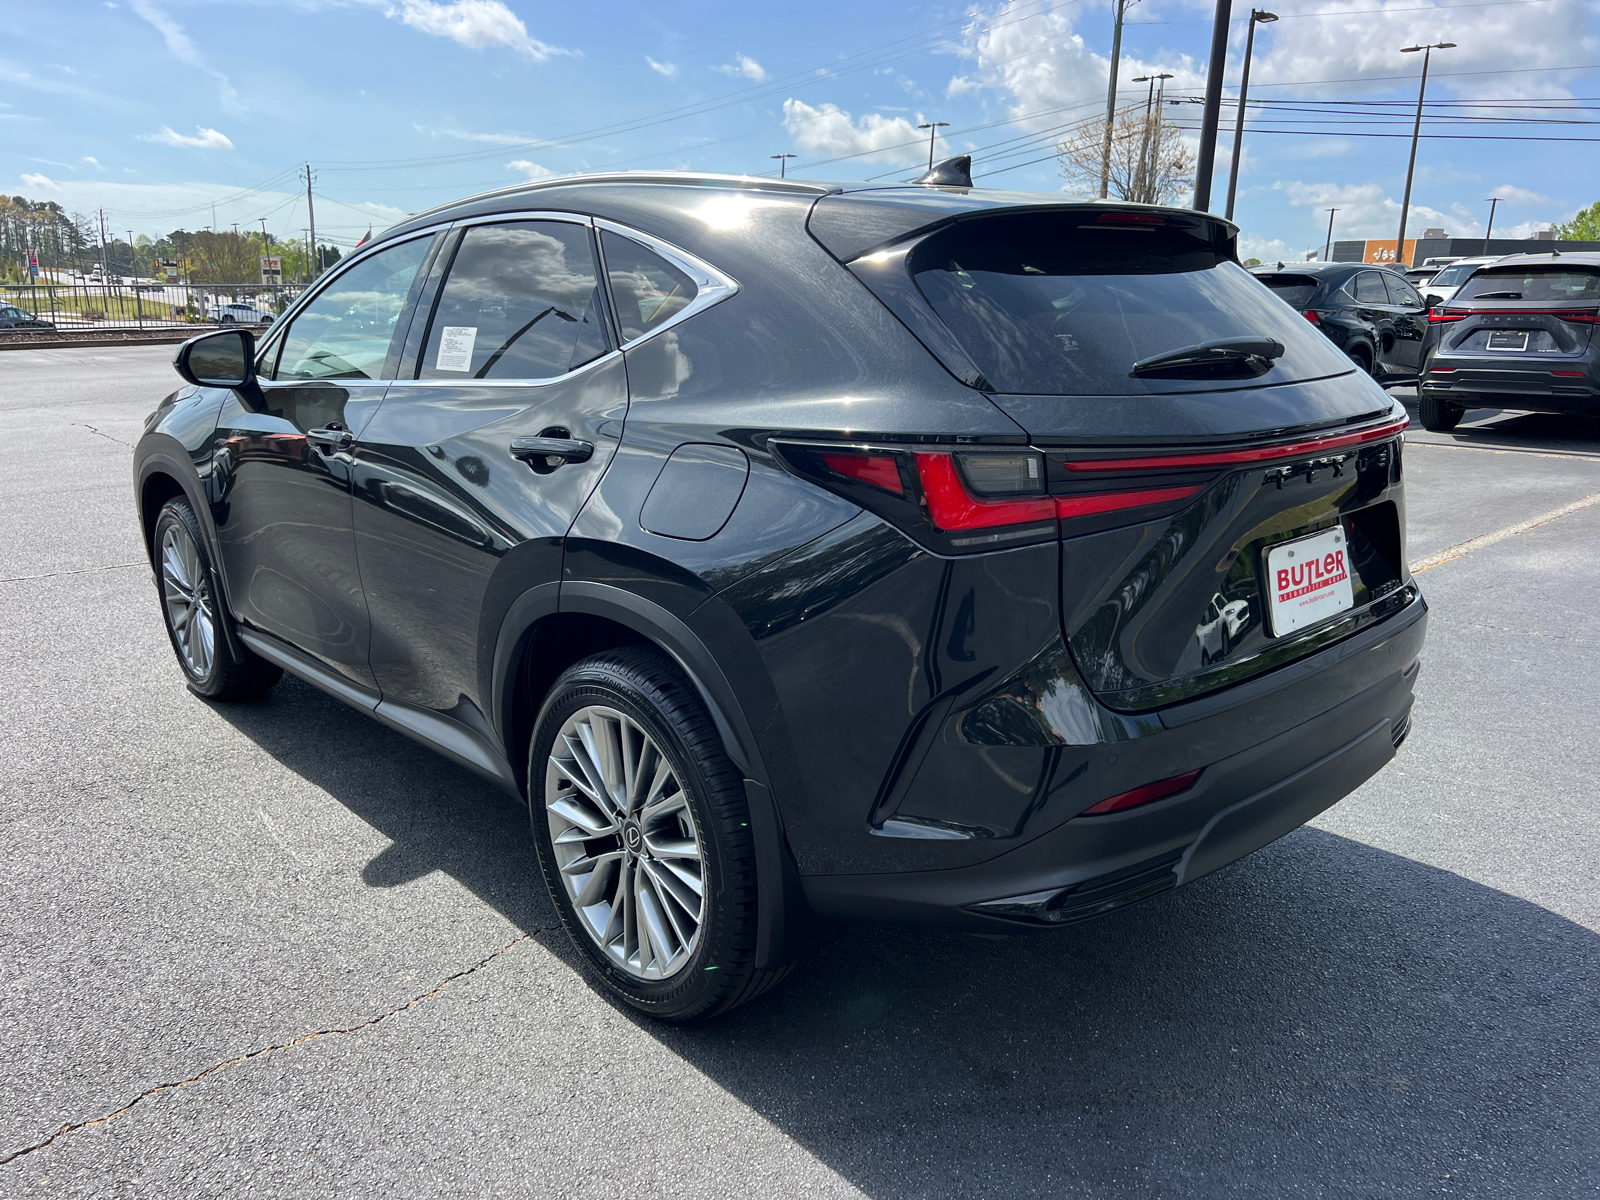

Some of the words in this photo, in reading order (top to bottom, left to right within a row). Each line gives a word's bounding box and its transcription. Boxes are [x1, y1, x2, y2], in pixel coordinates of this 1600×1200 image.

[1373, 247, 1396, 260] Jee
[1279, 581, 1323, 602] AUTOMOTIVE
[1299, 590, 1335, 607] www.butlercars.com
